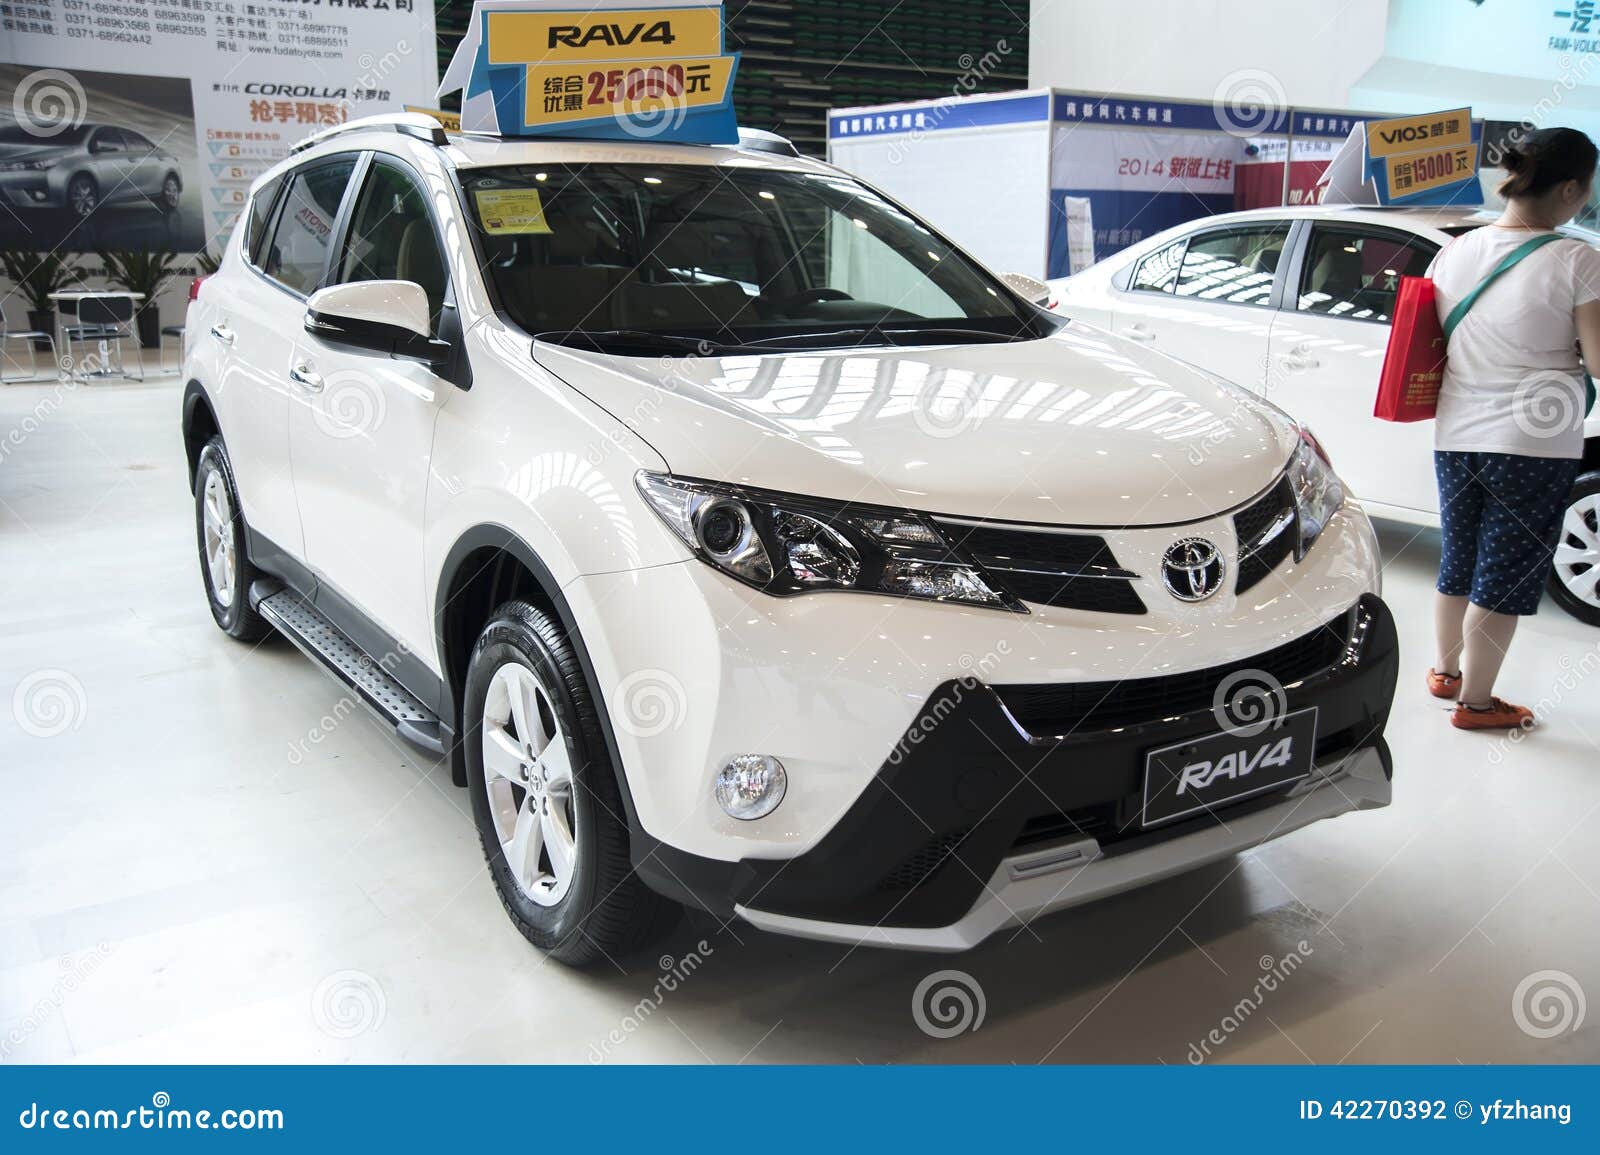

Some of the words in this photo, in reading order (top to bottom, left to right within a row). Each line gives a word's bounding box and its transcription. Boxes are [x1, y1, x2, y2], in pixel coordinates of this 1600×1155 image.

[547, 21, 675, 49] RAV4
[244, 83, 347, 99] COROLLA
[543, 75, 584, 96] 综合
[543, 94, 584, 113] 优惠
[1380, 124, 1429, 144] VIOS
[1118, 158, 1166, 177] 2014
[1176, 736, 1293, 796] RAV4
